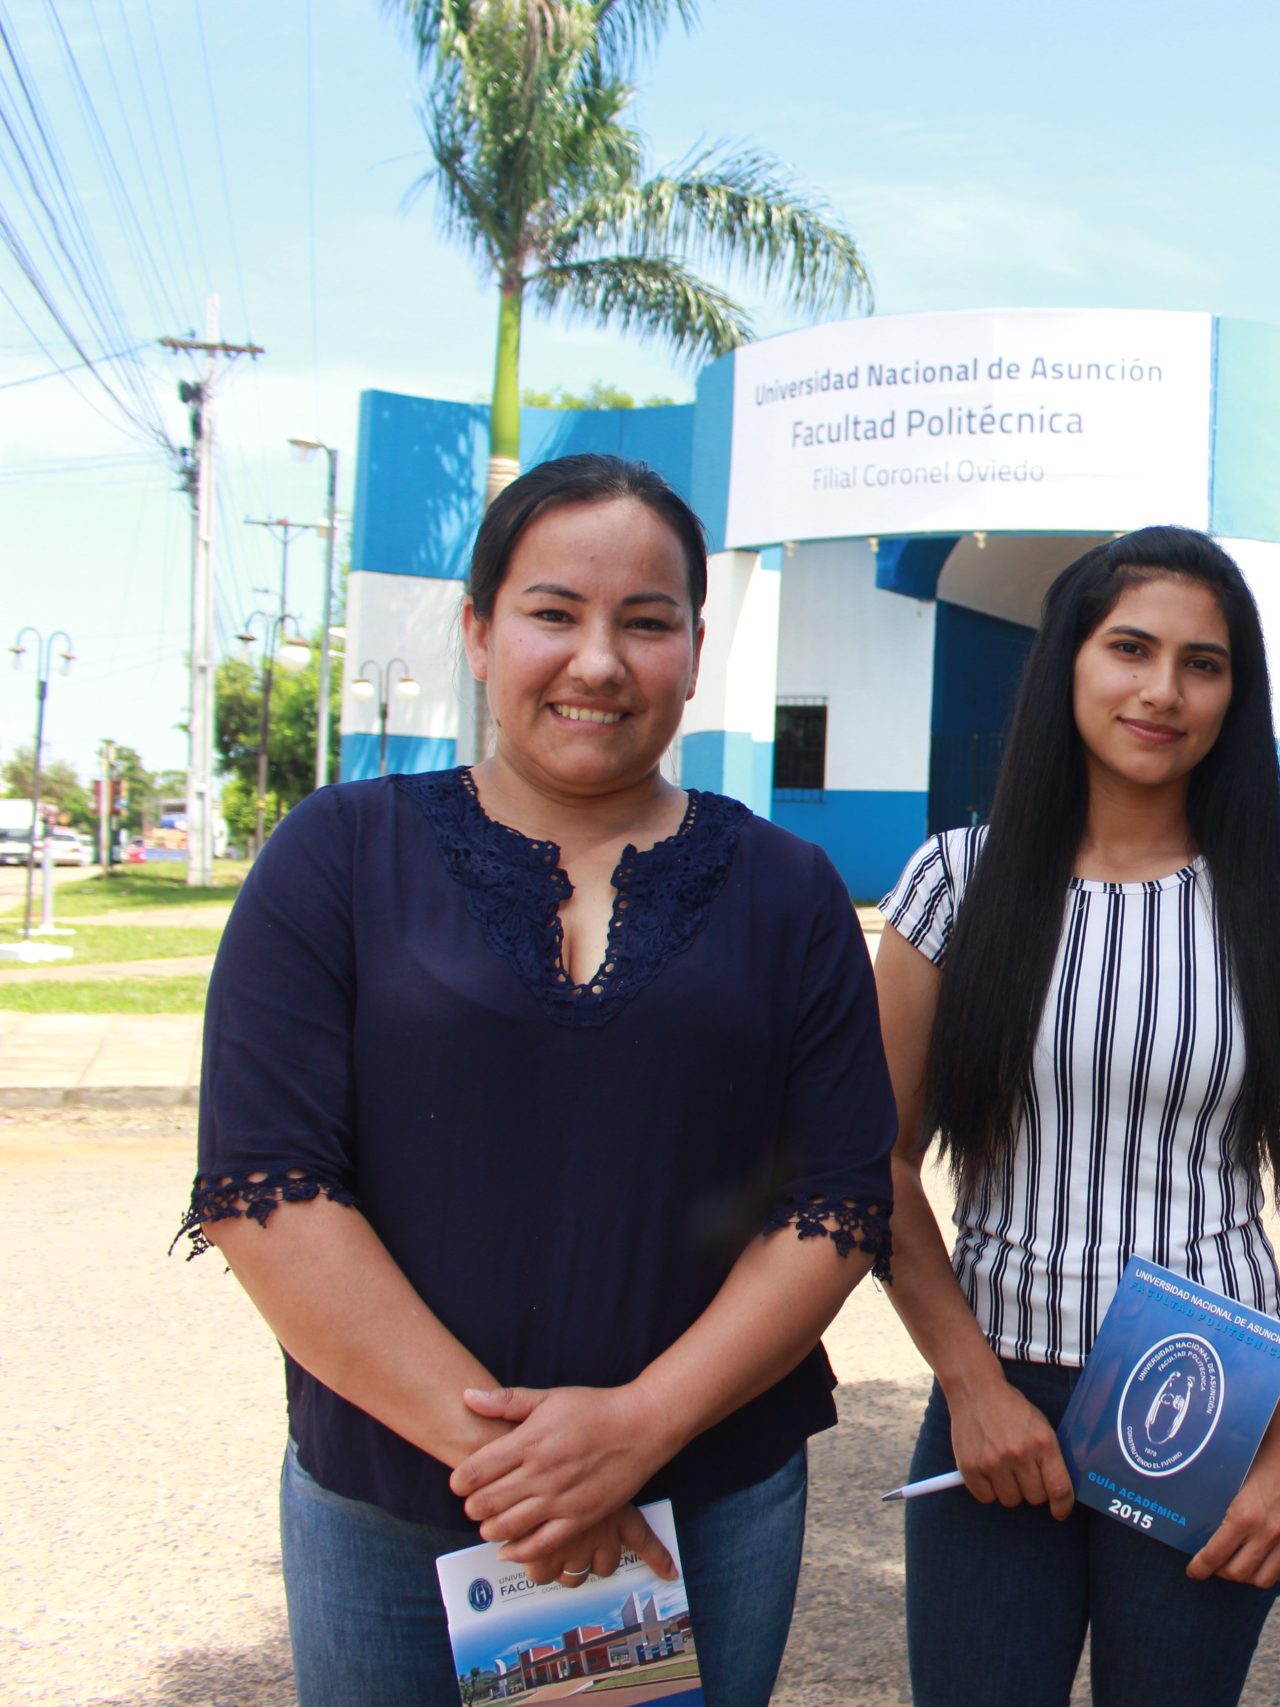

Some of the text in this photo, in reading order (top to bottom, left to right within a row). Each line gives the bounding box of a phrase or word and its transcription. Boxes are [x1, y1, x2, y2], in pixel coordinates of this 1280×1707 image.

[755, 357, 1162, 406] Universidad Nacional de Asunción
[791, 404, 1084, 449] Facultad Politécnica
[813, 459, 1045, 491] Filial Coronel Oviedo
[1129, 1280, 1195, 1318] FACULTAD
[1135, 1268, 1191, 1300] UNIVERSIDAD
[1190, 1295, 1233, 1322] NACIONAL
[1234, 1314, 1248, 1328] DE
[1138, 1344, 1175, 1381] UNIVERSIDAD
[1175, 1341, 1210, 1363] NACIONAL
[1207, 1362, 1216, 1374] DE
[1158, 1350, 1187, 1372] FACULTAD
[1126, 1425, 1152, 1469] CONSTRUYENDO
[1160, 1451, 1183, 1467] FUTURO
[1088, 1471, 1186, 1527] GUÍA ACADÉMICA
[1108, 1499, 1154, 1529] 2015
[500, 1580, 541, 1596] FACU
